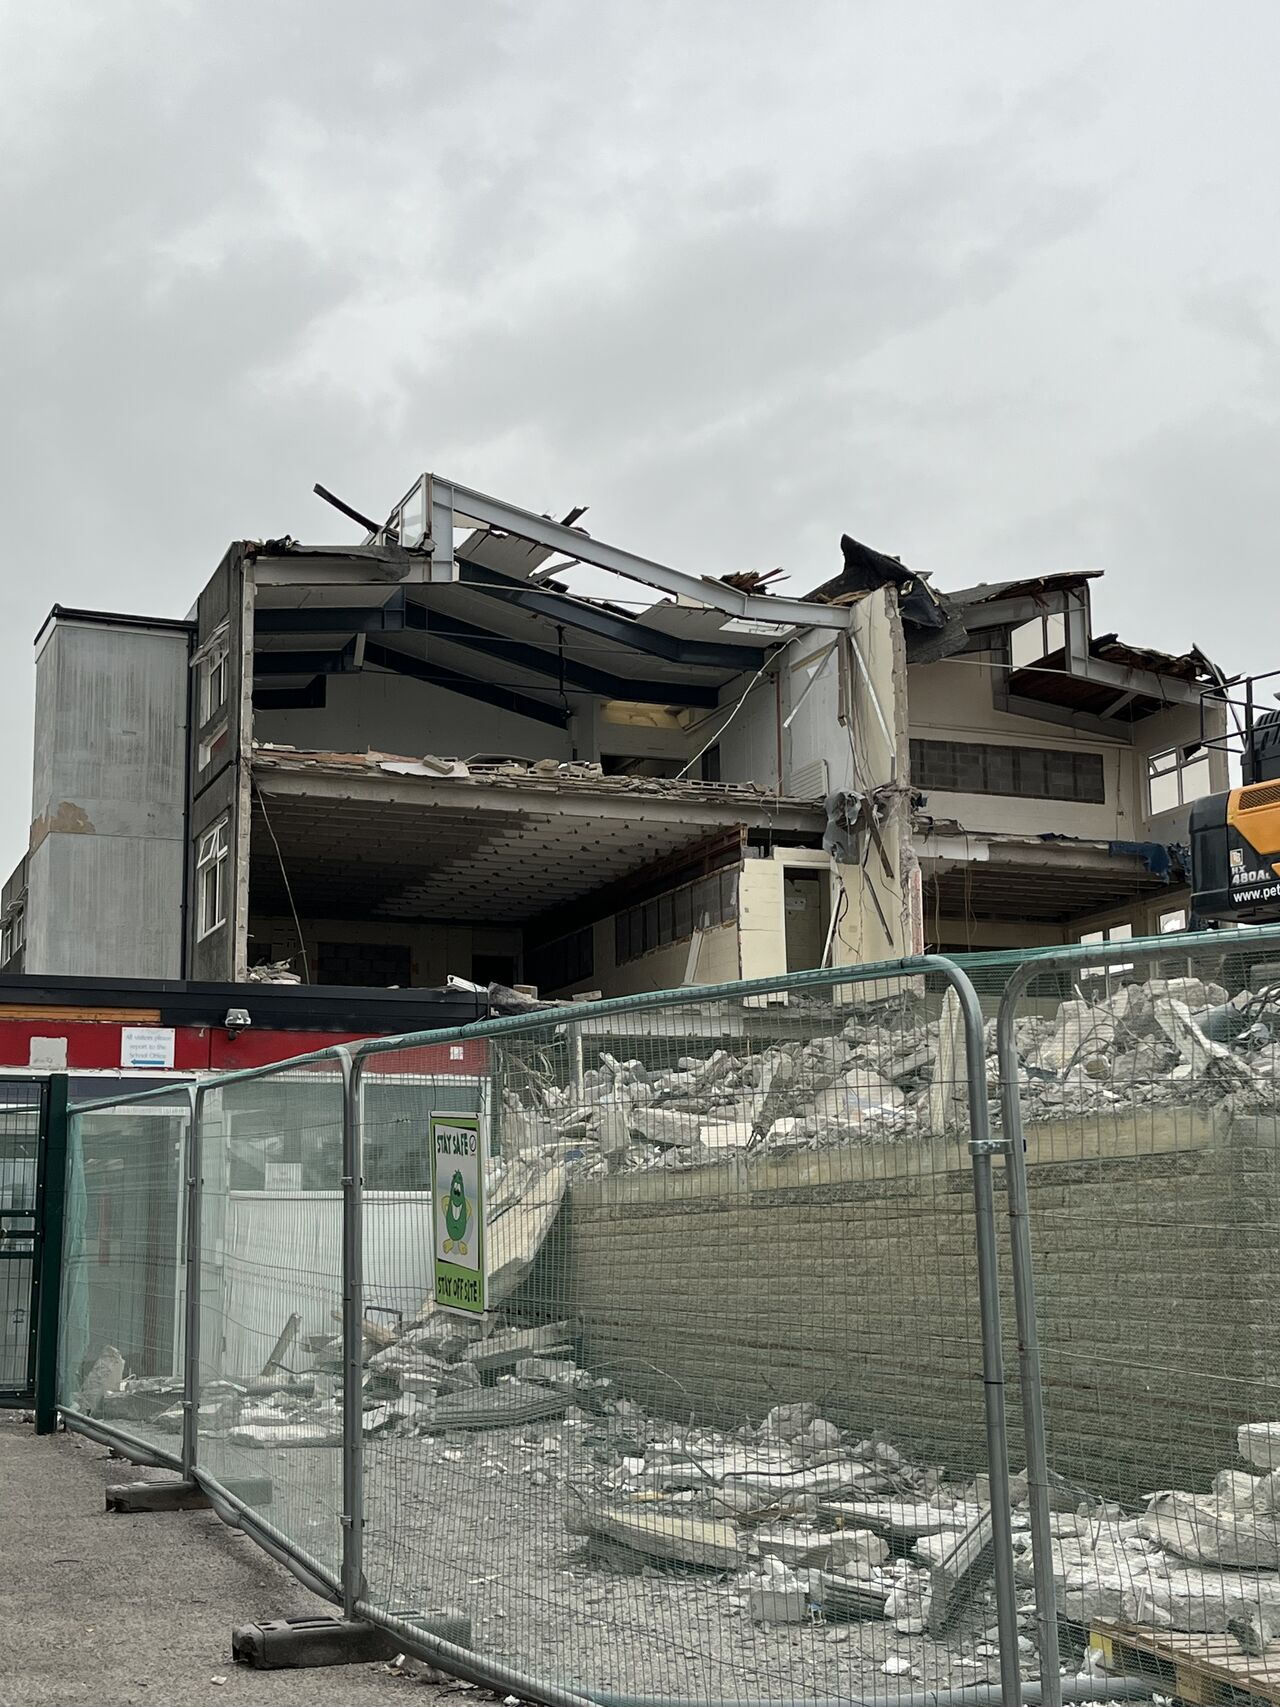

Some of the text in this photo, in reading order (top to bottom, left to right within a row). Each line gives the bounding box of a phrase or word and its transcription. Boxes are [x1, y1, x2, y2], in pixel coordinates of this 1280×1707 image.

[1231, 865, 1246, 875] HX
[437, 1132, 469, 1156] STAY SAFE
[438, 1275, 452, 1297] STAY
[453, 1277, 463, 1300] OFF
